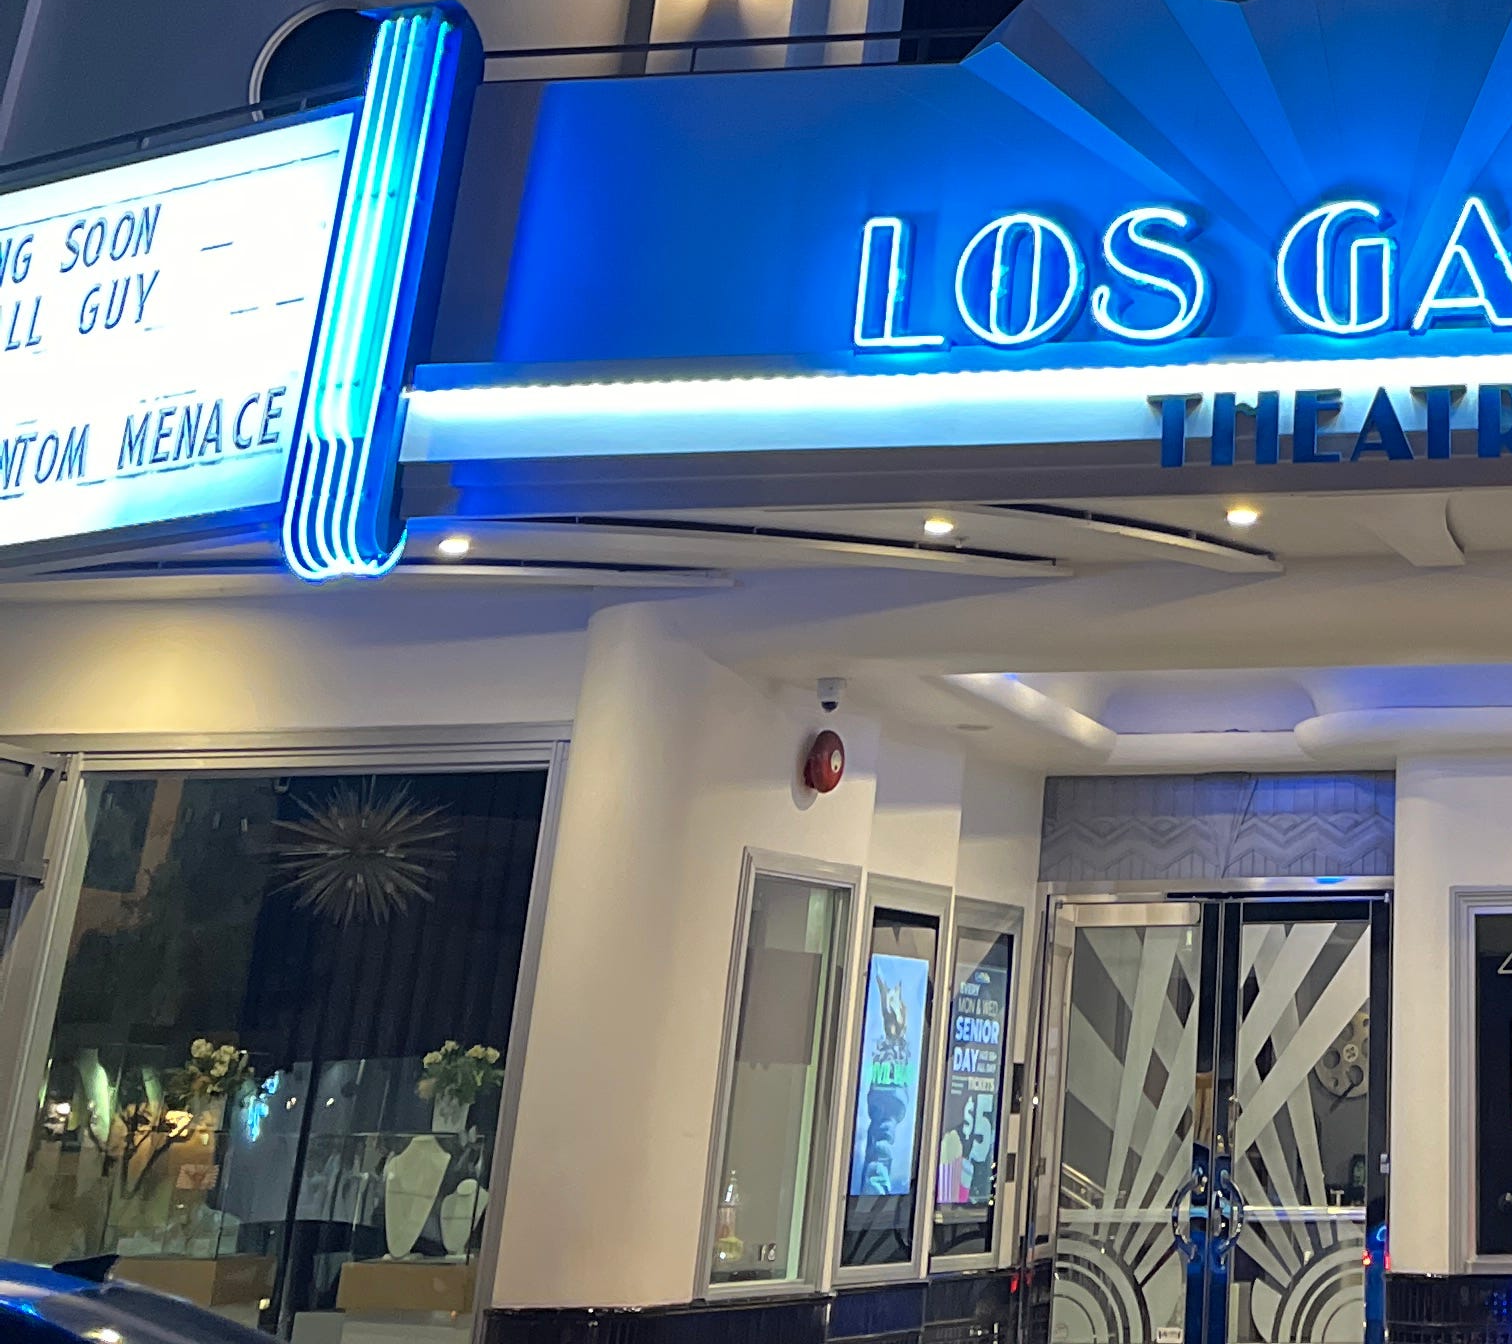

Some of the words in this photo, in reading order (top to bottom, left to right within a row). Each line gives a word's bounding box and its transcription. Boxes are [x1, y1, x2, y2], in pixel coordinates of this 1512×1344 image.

[60, 203, 162, 274] SOON
[78, 269, 160, 335] GUY
[853, 207, 1212, 352] LOS
[116, 385, 287, 471] MENACE
[955, 1015, 1000, 1045] SENIOR
[958, 997, 976, 1013] MON
[953, 1046, 979, 1072] DAY
[962, 1094, 993, 1163] $5
